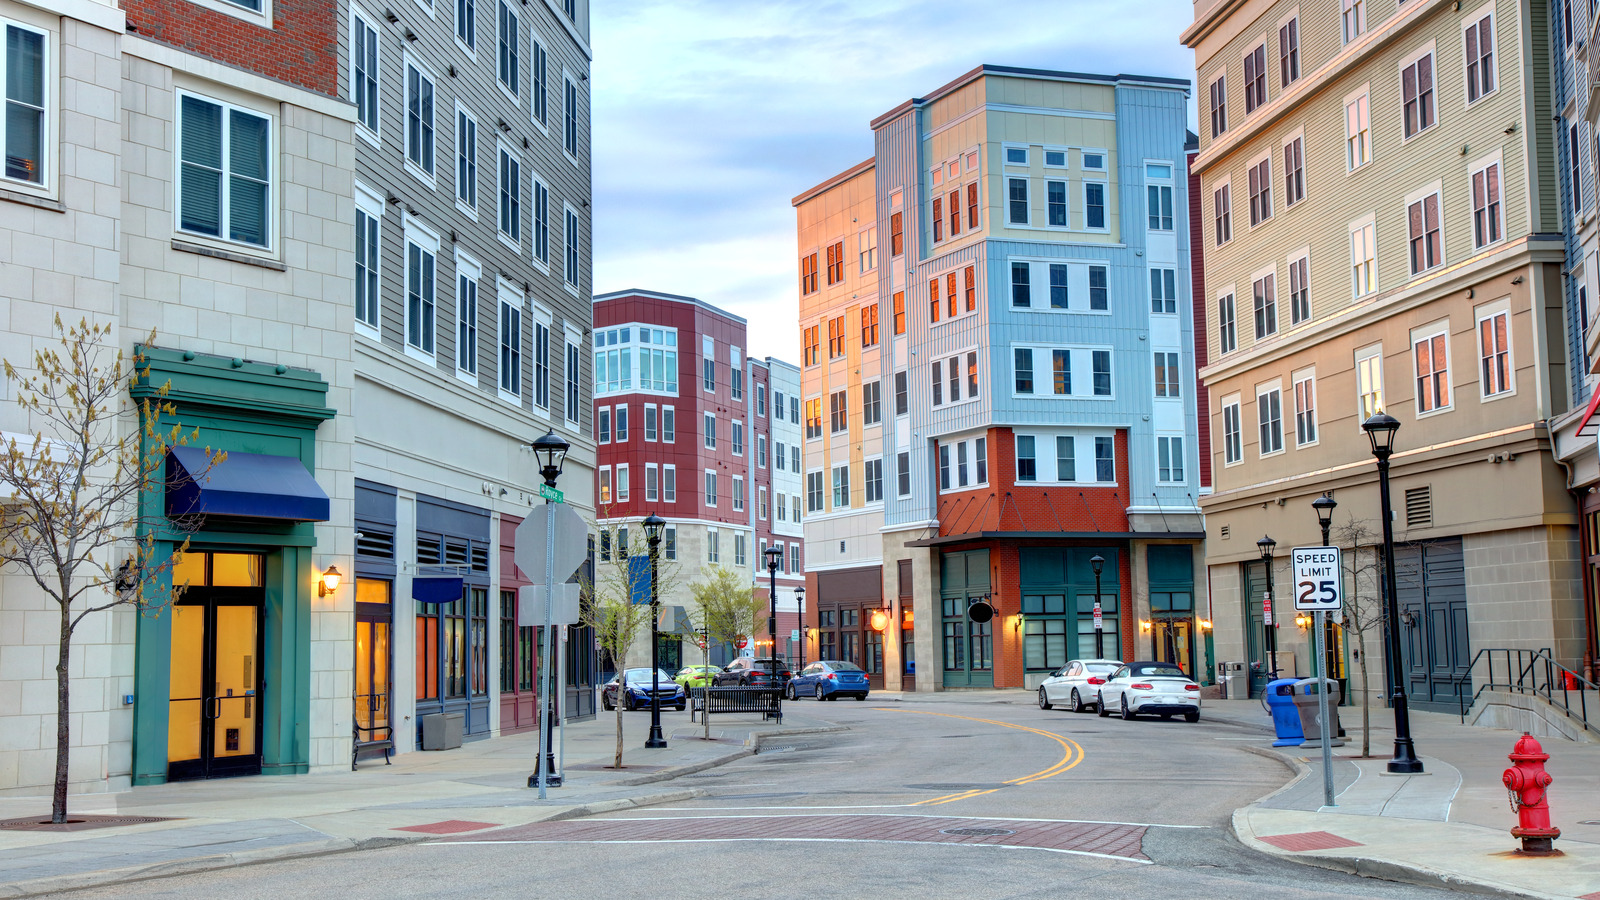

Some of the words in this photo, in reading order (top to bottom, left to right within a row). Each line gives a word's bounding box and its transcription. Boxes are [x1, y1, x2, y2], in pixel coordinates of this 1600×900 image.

[1296, 554, 1336, 564] SPEED
[1301, 567, 1332, 577] LIMIT
[1298, 581, 1337, 604] 25
